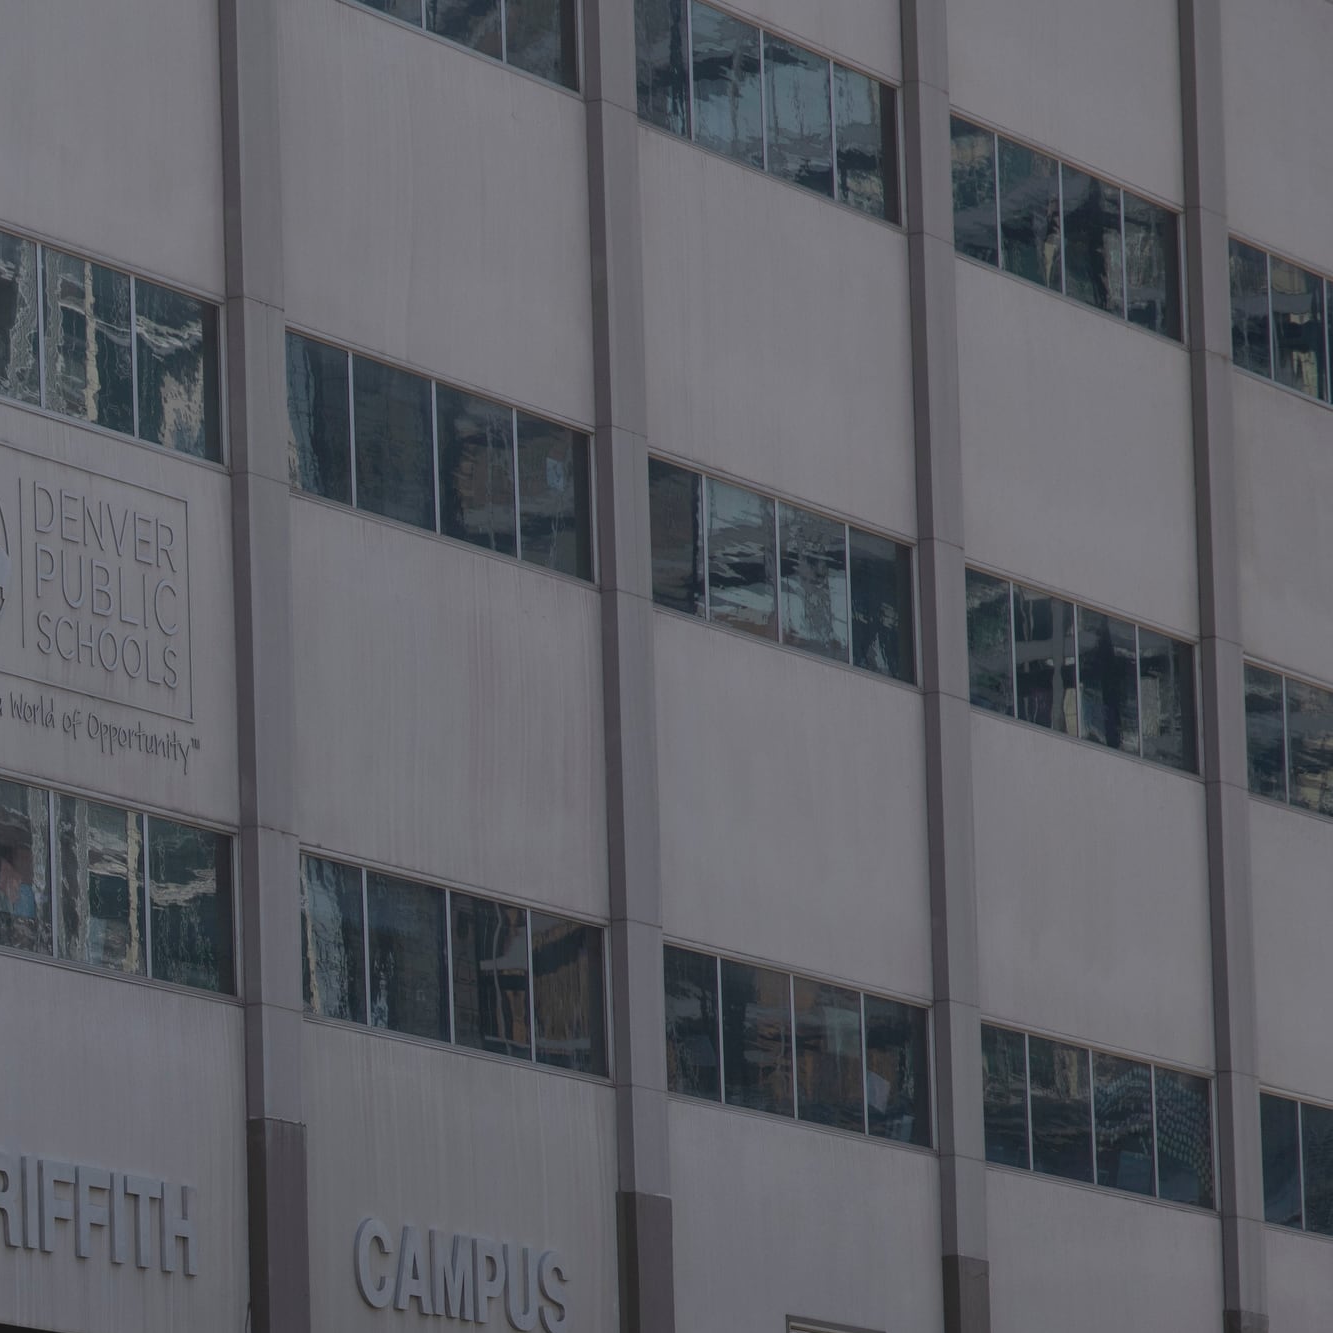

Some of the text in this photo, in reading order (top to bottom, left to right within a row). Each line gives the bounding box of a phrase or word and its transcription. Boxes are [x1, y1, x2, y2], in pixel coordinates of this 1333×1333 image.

[34, 480, 178, 574] DENVER
[35, 542, 181, 637] PUBLIC
[36, 610, 179, 690] SCHOOLS
[10, 691, 56, 730] World
[62, 709, 81, 740] of
